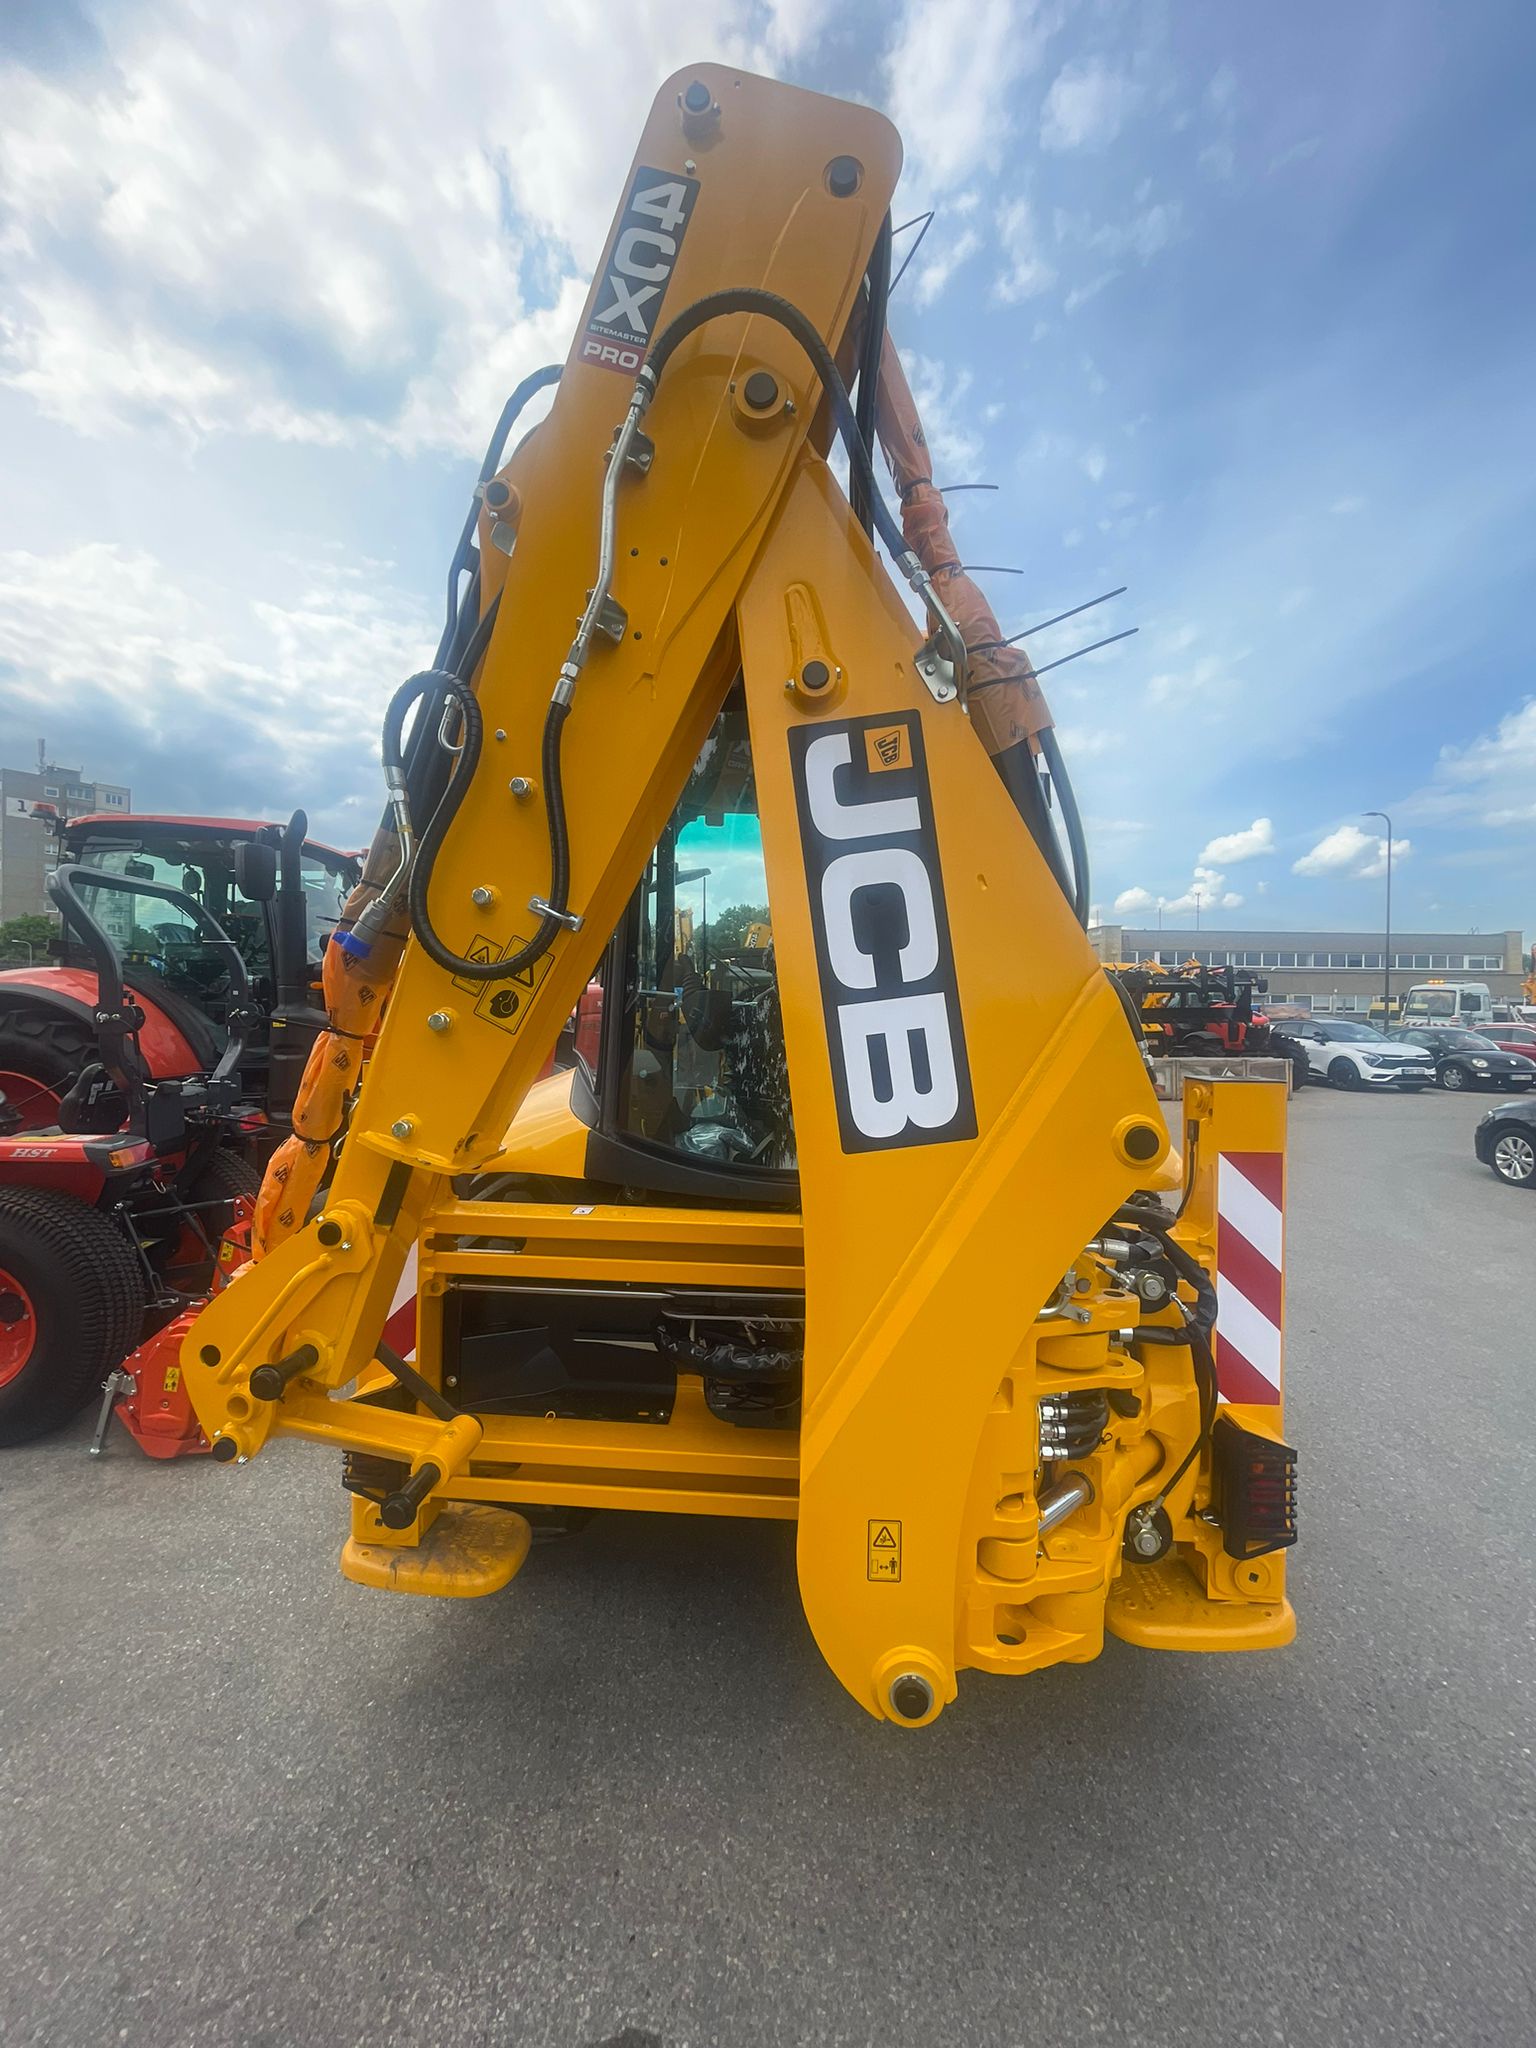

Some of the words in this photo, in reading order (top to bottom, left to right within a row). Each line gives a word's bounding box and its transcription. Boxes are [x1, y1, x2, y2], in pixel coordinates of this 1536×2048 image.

[594, 182, 687, 334] 4CX
[590, 324, 647, 344] SITEMASTER
[584, 341, 639, 369] PRO
[877, 735, 898, 764] JCB
[805, 733, 959, 1138] JCB
[9, 1148, 58, 1158] HST
